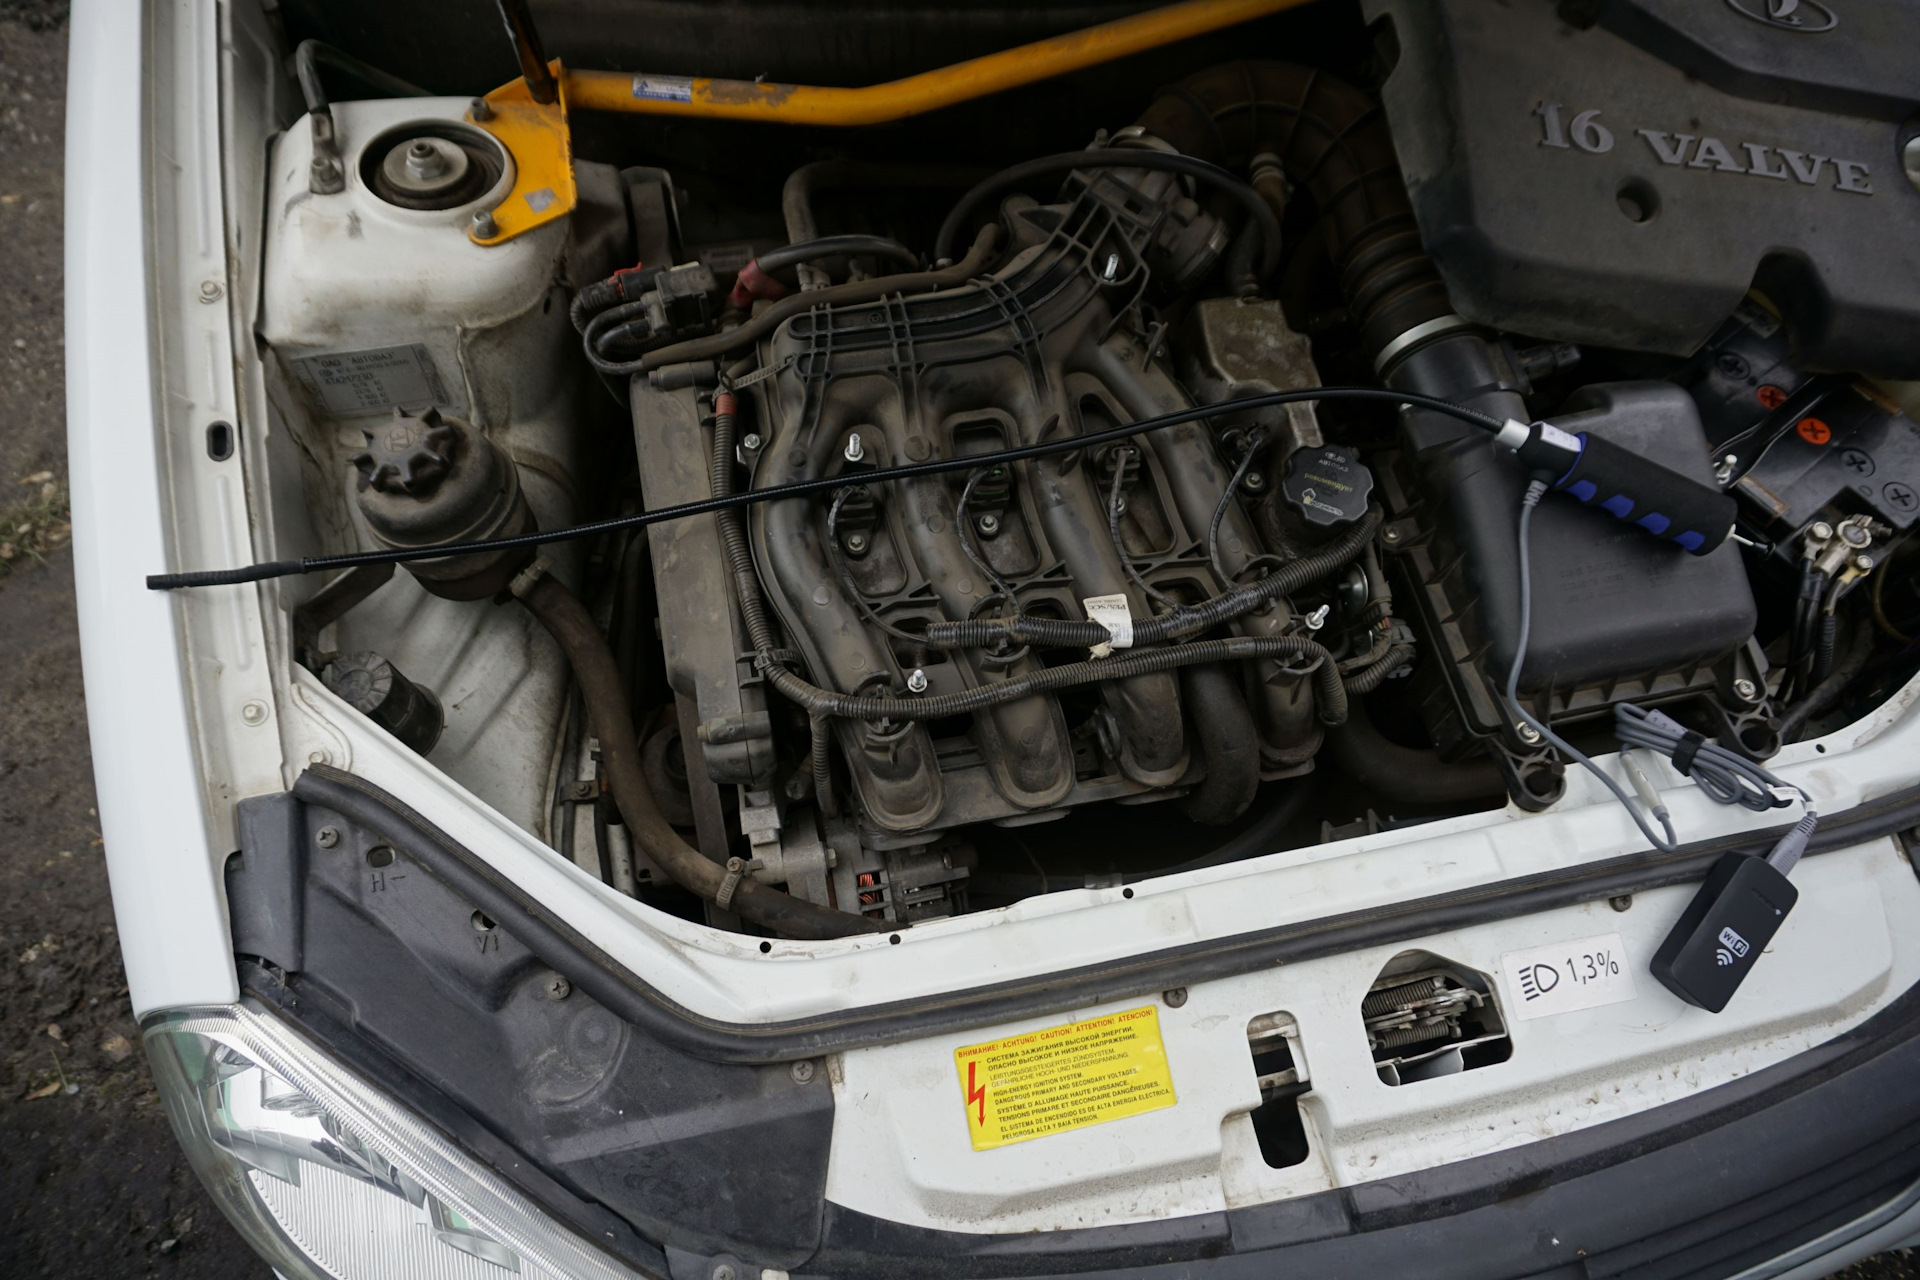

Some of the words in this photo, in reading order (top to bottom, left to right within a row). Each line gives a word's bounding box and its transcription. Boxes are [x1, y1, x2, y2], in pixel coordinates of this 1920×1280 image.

[1535, 102, 1614, 154] 16
[1636, 128, 1874, 196] VALVE
[1566, 950, 1619, 985] 1,3%
[958, 1044, 998, 1058] ВНИМАНИЕ!
[1003, 1035, 1036, 1049] ACHTUNG!
[1040, 1028, 1072, 1040] CAUTION!
[1076, 1018, 1114, 1032] ATTENTION!
[1118, 1010, 1152, 1022] ATENCION!
[987, 1052, 1019, 1063] СИСТЕМА
[1021, 1042, 1063, 1056] ЗАЖИГАНИЯ
[1065, 1033, 1100, 1046] ВЫСОКОЙ
[1101, 1026, 1133, 1038] ЭНЕРГИИ.
[988, 1060, 1017, 1071] ОПАСНО
[1018, 1052, 1052, 1065] ВЫСОКОЕ
[1061, 1044, 1088, 1055] НИЗКОЕ
[1090, 1033, 1138, 1048] НАПРЯЖЕНИЕ.
[993, 1083, 1031, 1097] HIGH-ENERGY
[1033, 1078, 1058, 1088] IGNITION
[1036, 1069, 1056, 1077] HOCH-
[1070, 1088, 1091, 1098] HAUTE
[1092, 1080, 1129, 1093] PUISSANCE.
[995, 1092, 1030, 1105] DANGEROUS
[1032, 1086, 1056, 1096] PRIMARY
[1071, 1075, 1105, 1088] SECONDARY
[999, 1111, 1030, 1122] TENSIONS
[1070, 1092, 1111, 1106] SECONDAIRE
[1009, 1120, 1034, 1130] SISTEMA
[1044, 1110, 1077, 1122] ENCENDIDO
[1112, 1096, 1137, 1107] ENERGIA
[1002, 1128, 1035, 1140] PELIGROSA
